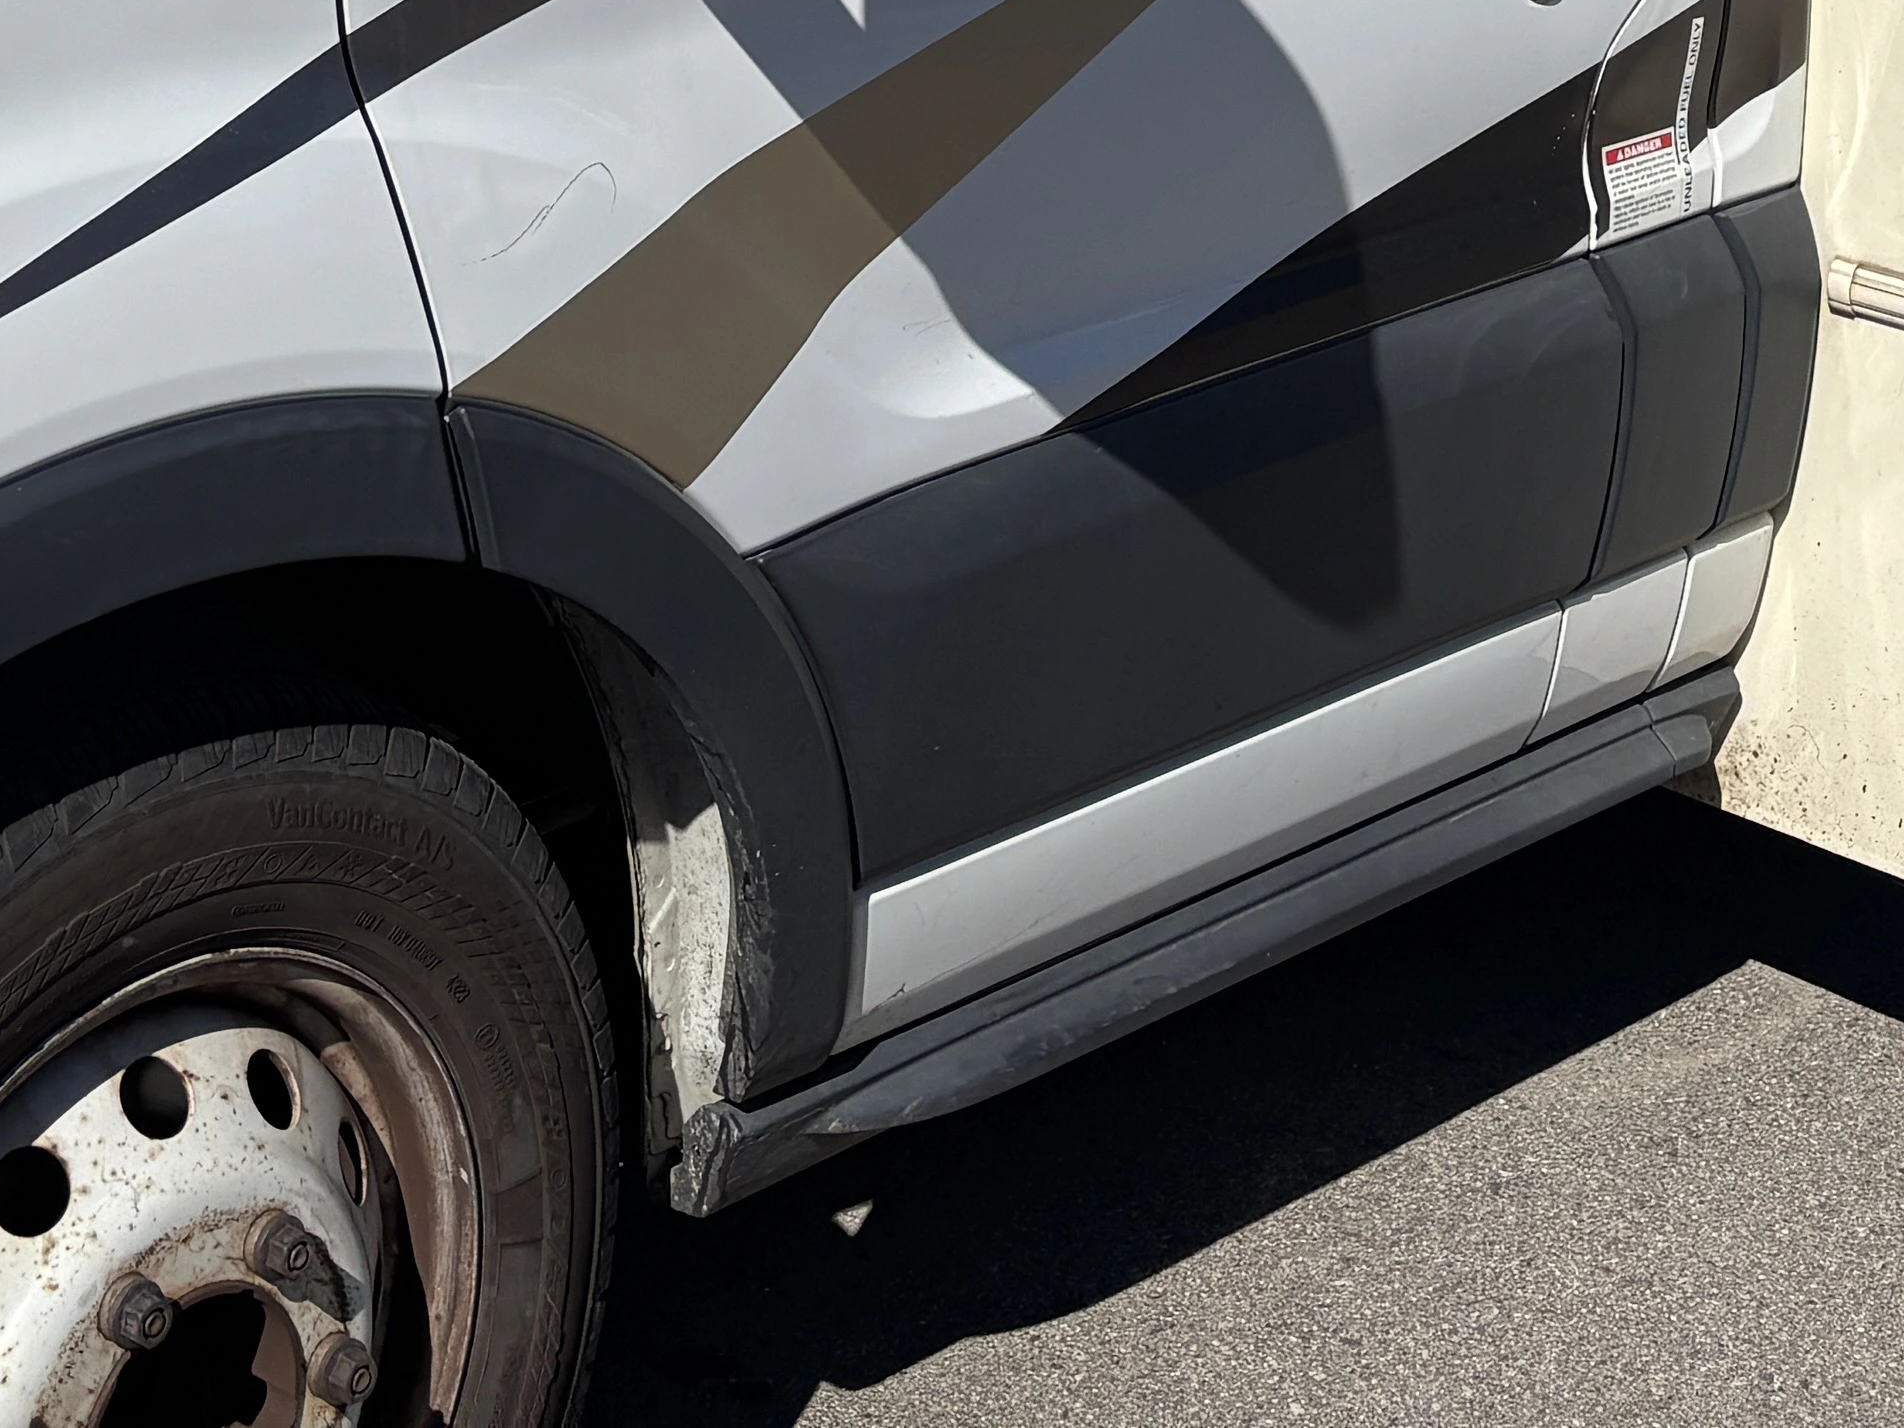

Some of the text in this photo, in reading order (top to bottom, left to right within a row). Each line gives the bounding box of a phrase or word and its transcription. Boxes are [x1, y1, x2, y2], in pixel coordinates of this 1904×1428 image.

[1678, 116, 1694, 213] UNLEADED
[1688, 22, 1701, 66] ONLY
[266, 795, 409, 847] VanContact
